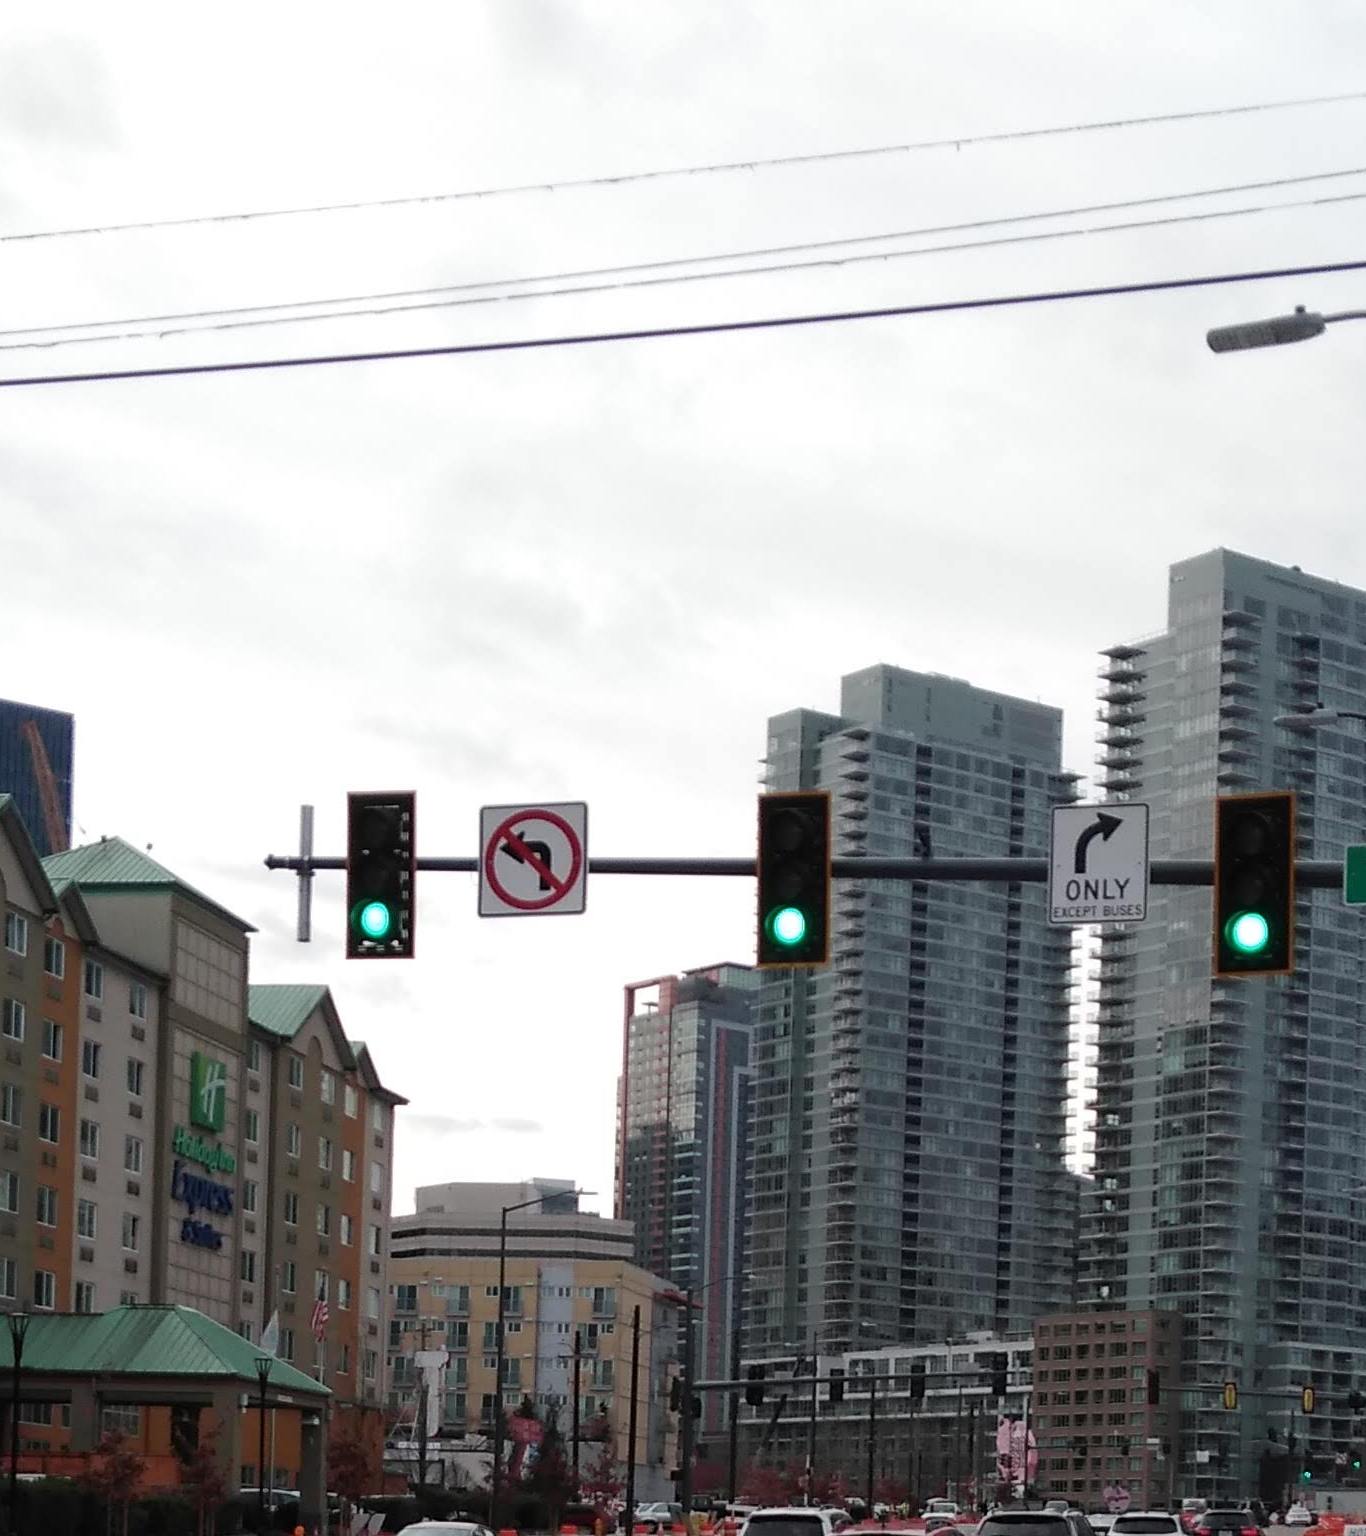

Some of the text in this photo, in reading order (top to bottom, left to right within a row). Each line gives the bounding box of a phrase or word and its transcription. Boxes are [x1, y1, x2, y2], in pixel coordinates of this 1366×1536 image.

[1066, 878, 1130, 901] ONLY
[1054, 904, 1142, 918] EXCEPT BUSES
